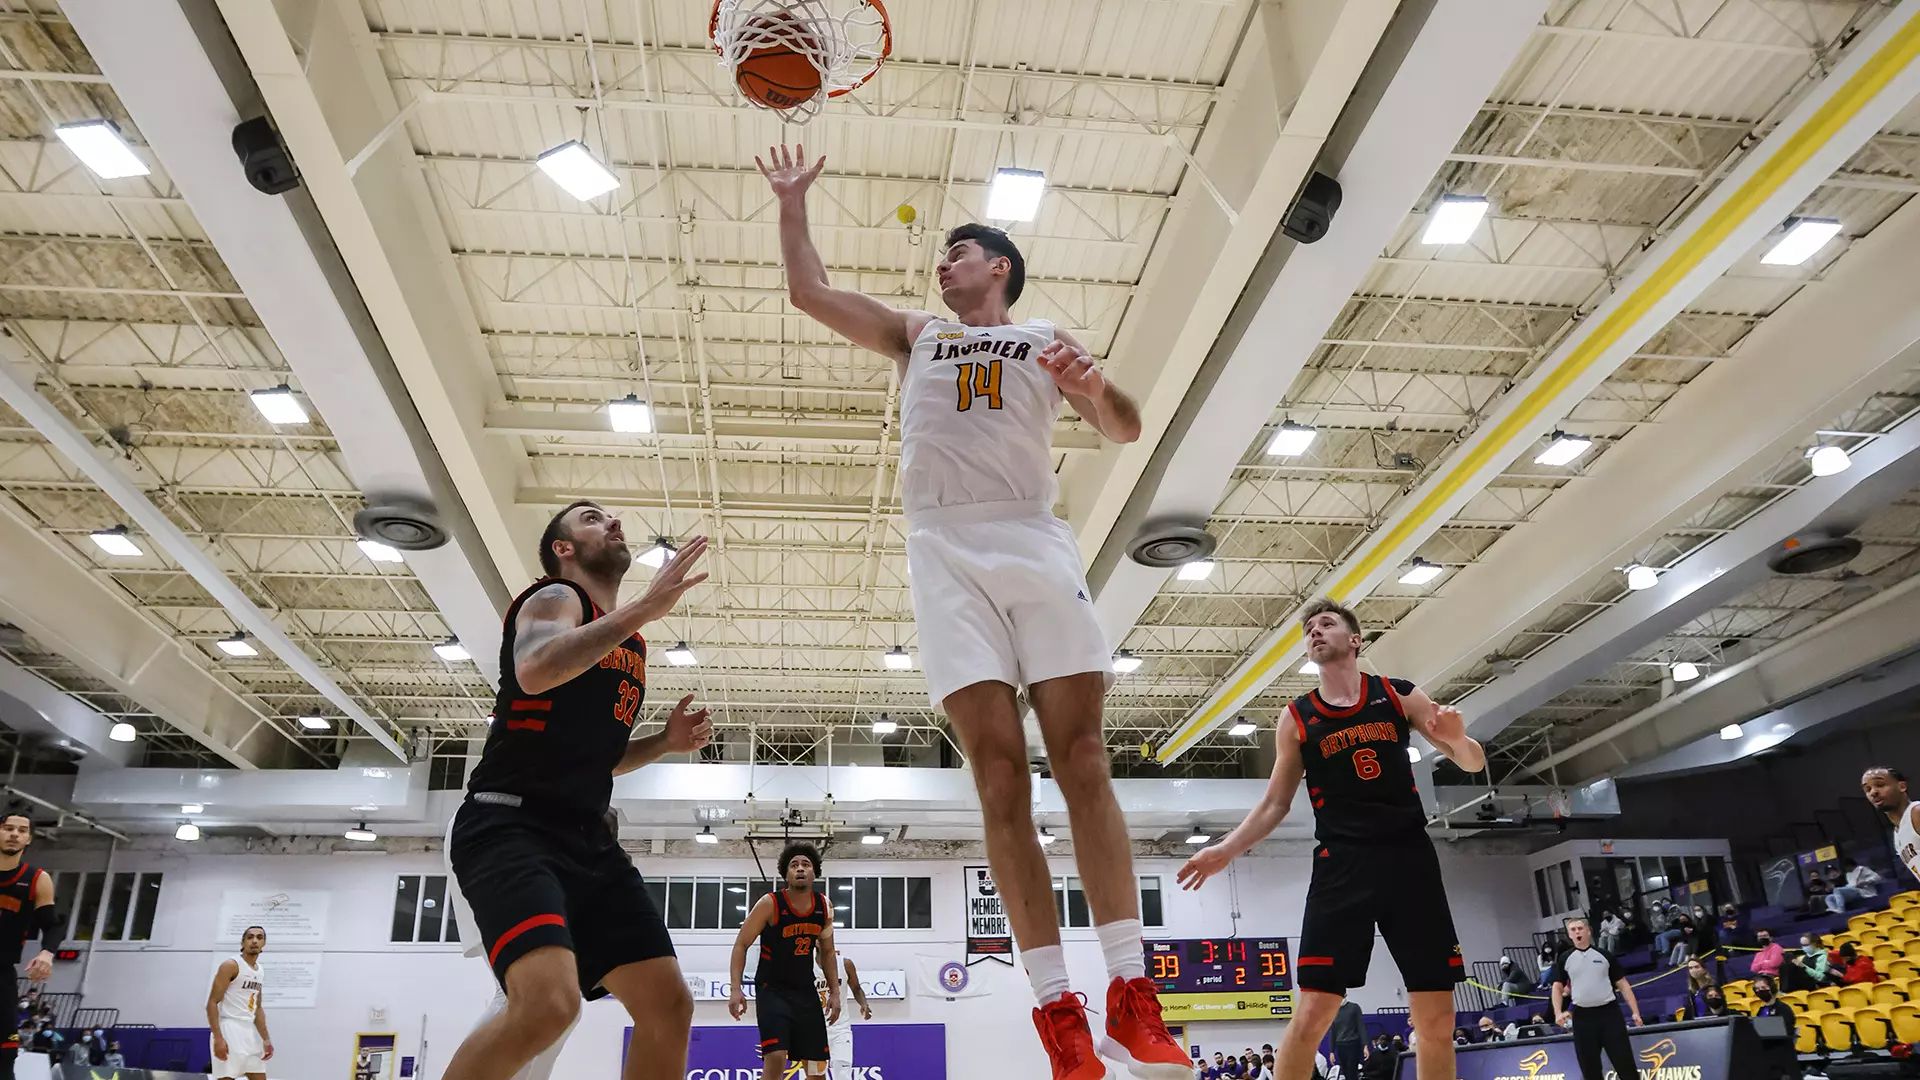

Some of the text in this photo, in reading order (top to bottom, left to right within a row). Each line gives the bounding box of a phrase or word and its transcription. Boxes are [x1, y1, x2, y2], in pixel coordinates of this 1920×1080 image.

[955, 359, 1003, 412] 14
[613, 680, 640, 727] 32
[1320, 723, 1397, 758] GRYPHONS
[1353, 748, 1381, 780] 6
[972, 917, 1007, 935] MEMBRE
[794, 937, 811, 956] 22
[1153, 943, 1171, 951] Home
[1201, 940, 1247, 963] 3:14
[1153, 952, 1287, 978] 39 33
[1202, 967, 1246, 984] period 2
